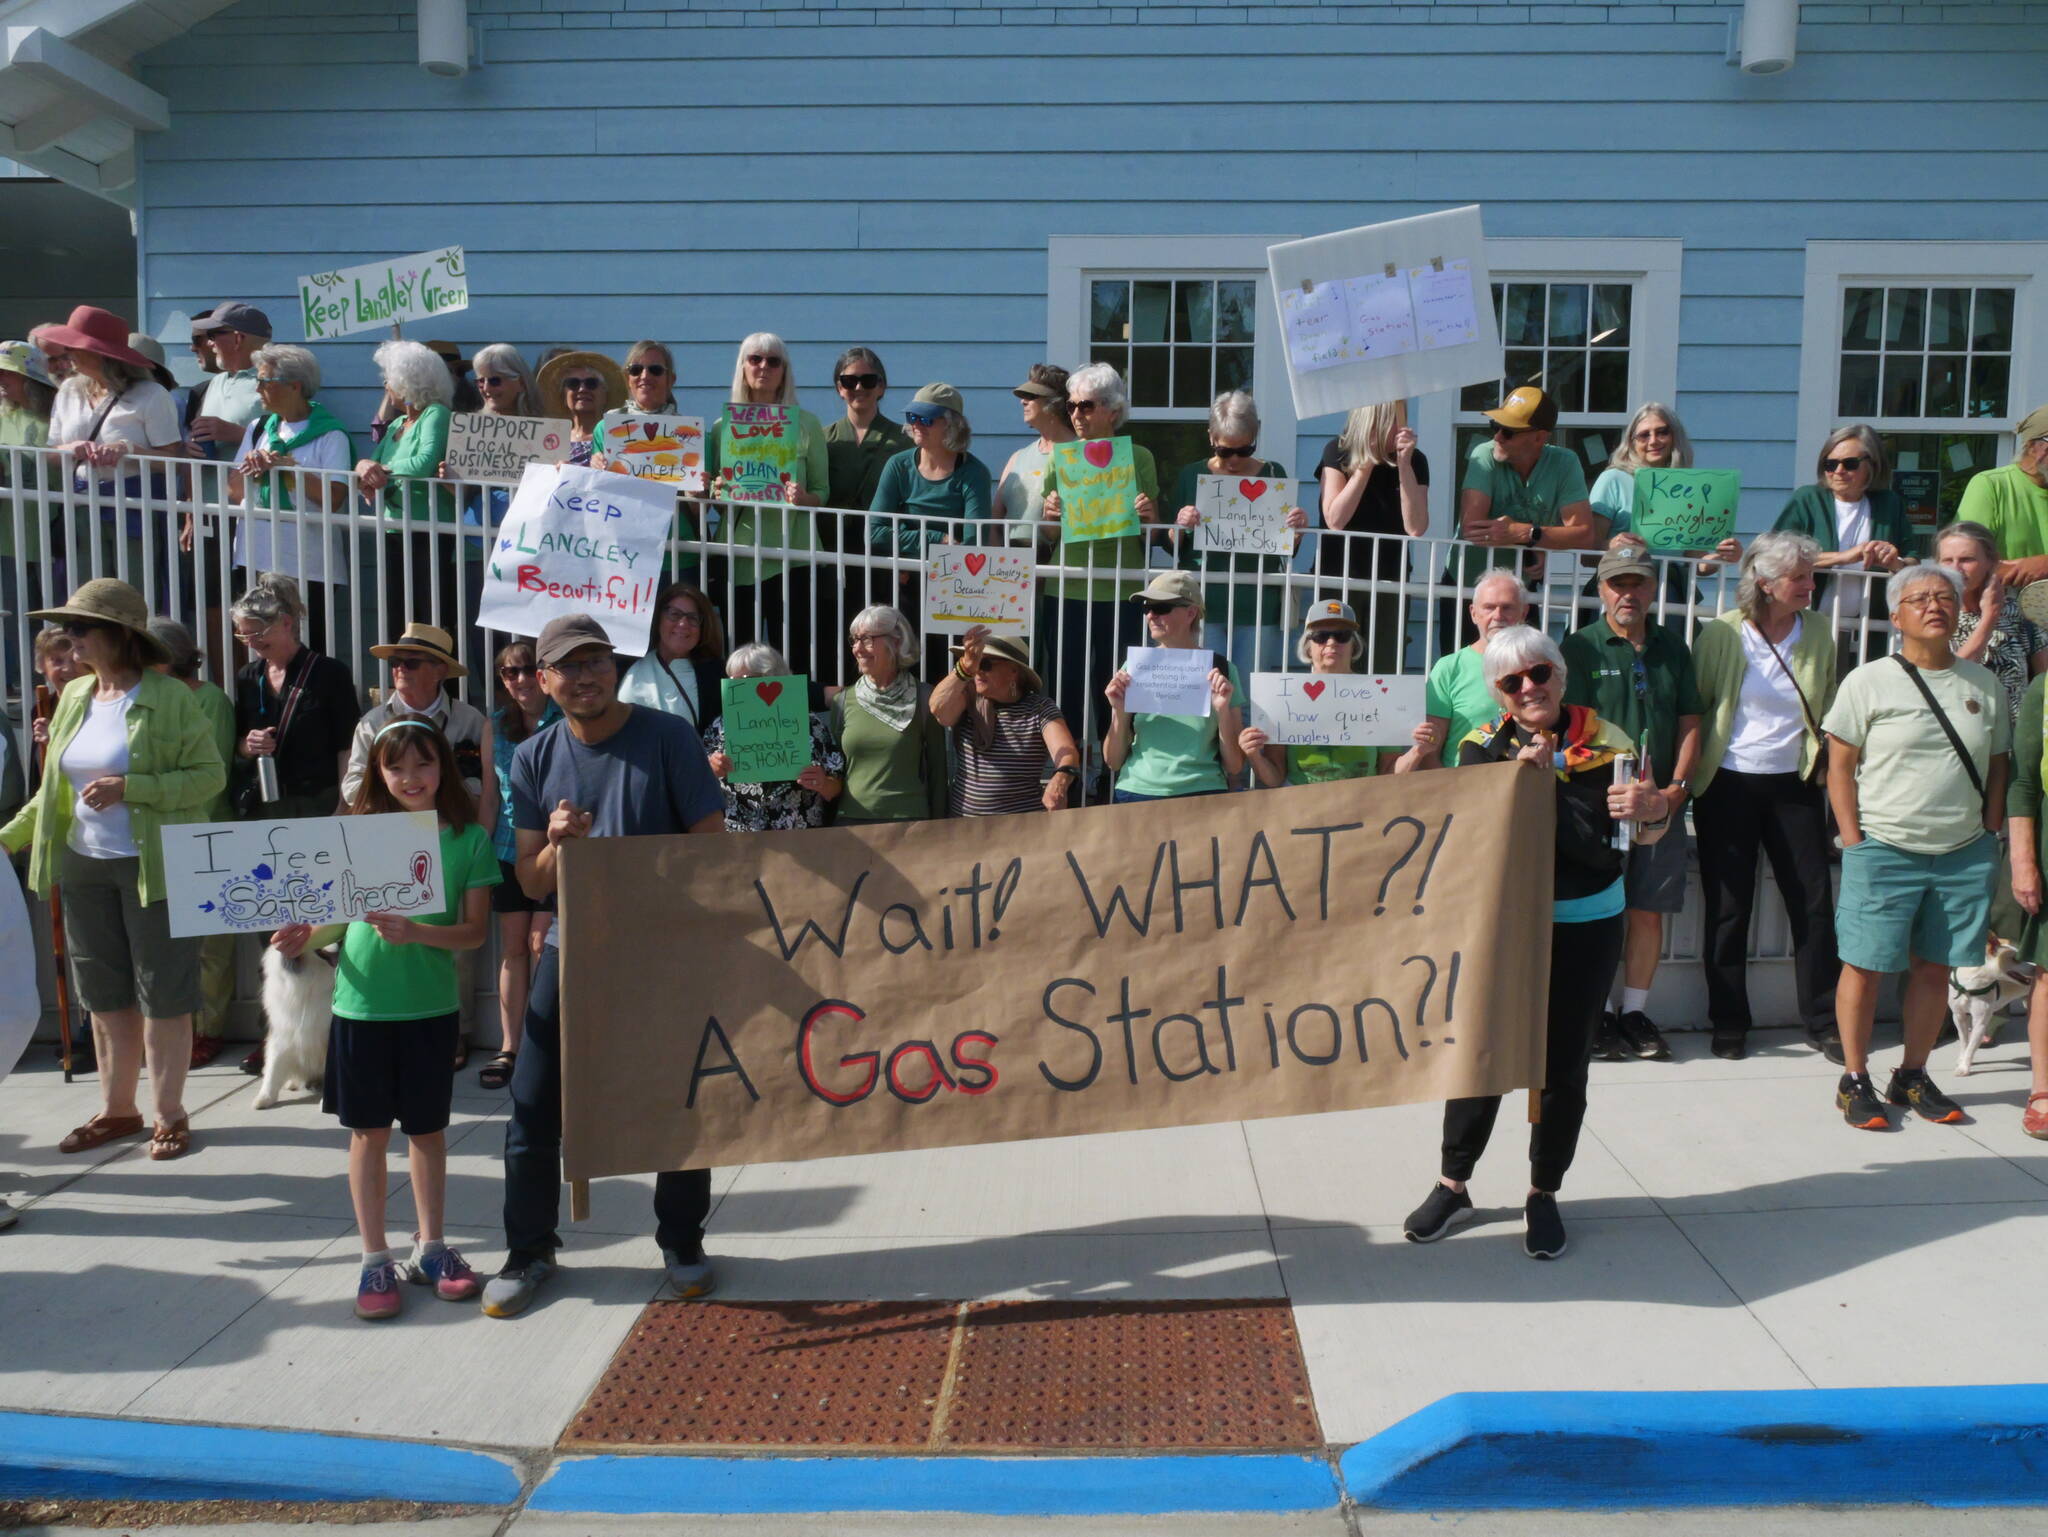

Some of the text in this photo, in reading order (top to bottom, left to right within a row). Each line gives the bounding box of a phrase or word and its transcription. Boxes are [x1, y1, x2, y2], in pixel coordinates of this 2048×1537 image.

[302, 267, 467, 337] Keep Langley Green
[452, 412, 544, 440] SUPPORT
[621, 419, 637, 443] I
[731, 423, 784, 439] LOVE
[466, 437, 516, 457] LOCAL
[1060, 448, 1078, 464] I
[548, 480, 622, 521] Keep
[1211, 480, 1224, 499] I
[1649, 471, 1712, 504] Keep
[1218, 501, 1275, 527] Langley's
[516, 522, 640, 569] LANGLEY
[1205, 523, 1278, 553] Night Sky
[939, 553, 1022, 581] I Langley
[517, 564, 653, 614] Beautiful!
[728, 682, 745, 706] I
[1276, 678, 1373, 699] I love
[737, 704, 800, 741] Langley
[1285, 700, 1380, 730] how quiet
[1277, 721, 1351, 745] Langley is
[756, 750, 802, 768] HOME
[193, 822, 352, 875] I feel
[229, 878, 325, 922] Safe
[754, 813, 1455, 962] Wait! WHAT?!
[686, 951, 1463, 1110] A Gas Station?!
